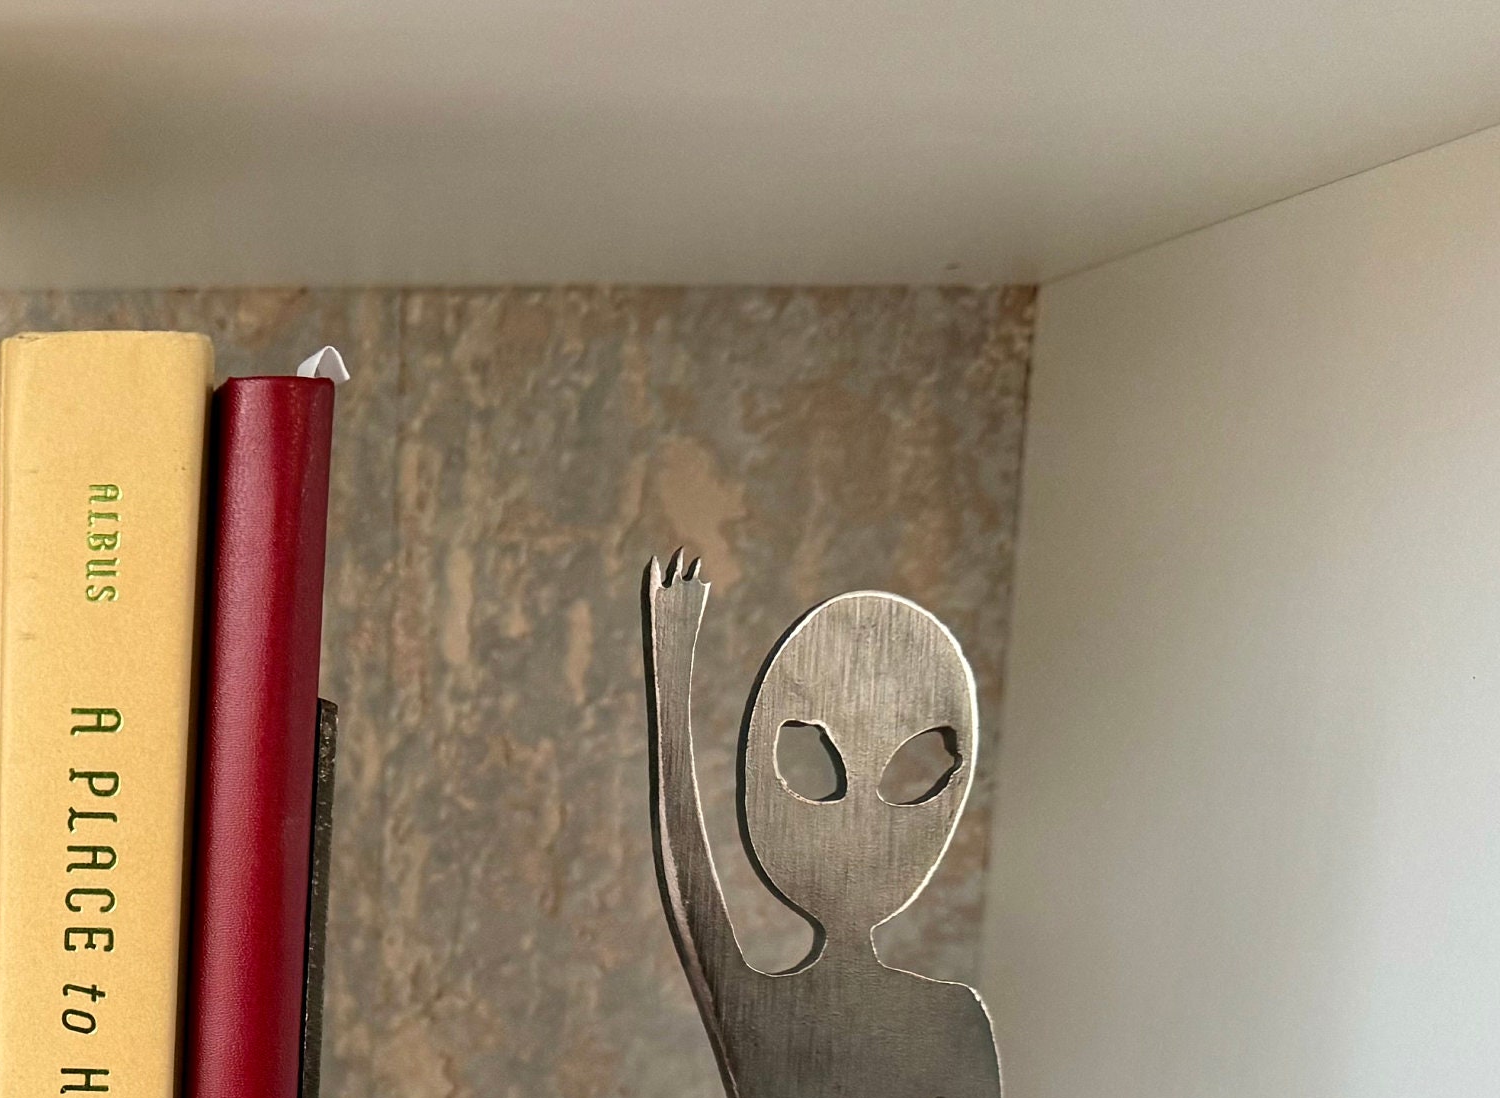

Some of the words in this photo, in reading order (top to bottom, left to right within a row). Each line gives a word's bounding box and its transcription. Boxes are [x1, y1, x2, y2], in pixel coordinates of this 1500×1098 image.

[86, 484, 122, 602] ALBUS
[70, 707, 124, 736] A
[63, 767, 120, 952] PLACE
[61, 983, 106, 1035] to
